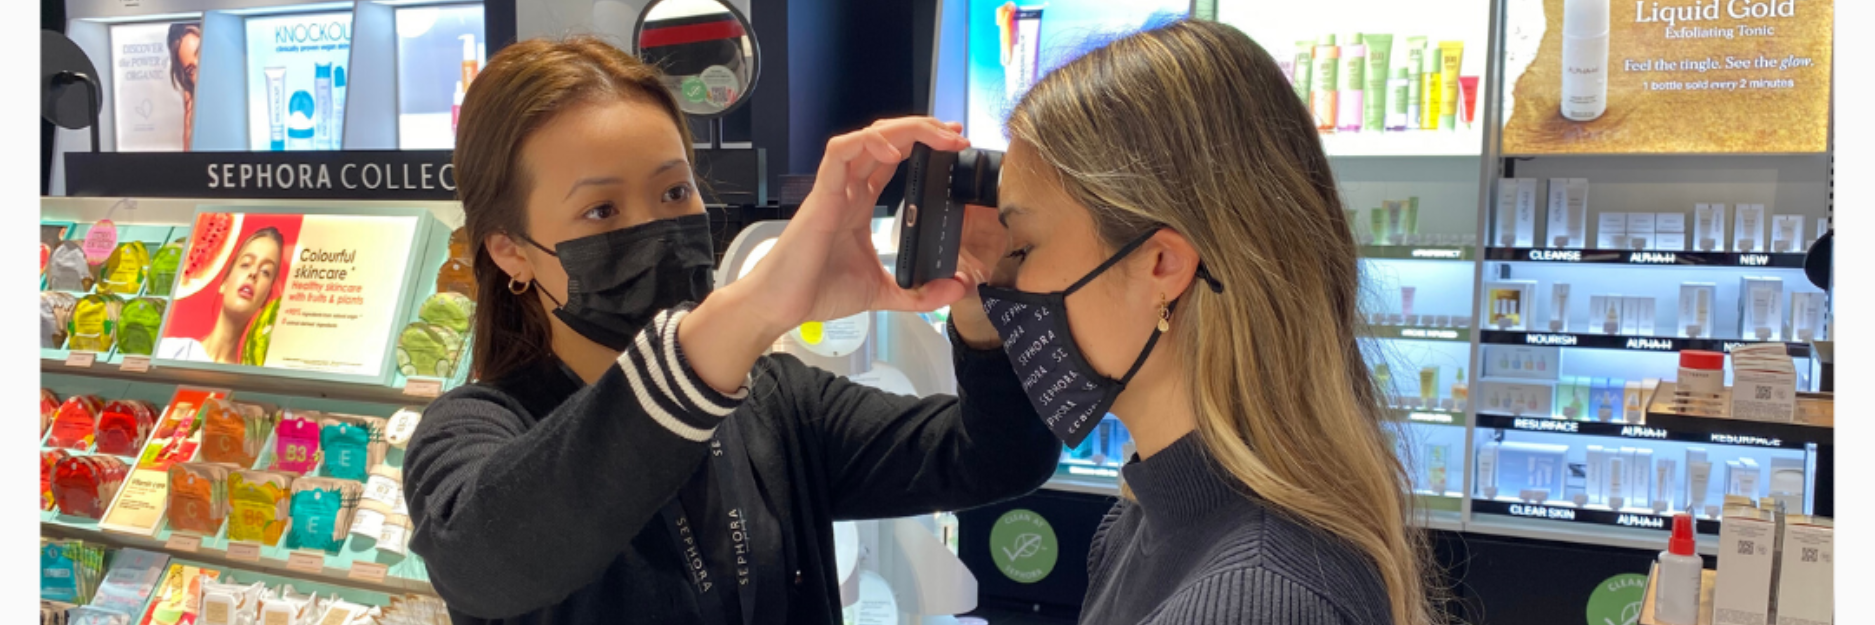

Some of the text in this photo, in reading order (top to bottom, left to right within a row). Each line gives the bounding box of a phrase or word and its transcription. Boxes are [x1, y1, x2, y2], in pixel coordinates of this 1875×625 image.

[1635, 0, 1795, 26] Liquid Gold
[1665, 24, 1775, 39] Exfoliating Tonic
[123, 42, 164, 54] DISCOVER
[118, 57, 131, 67] the
[132, 56, 161, 67] POWER
[1624, 54, 1814, 72] Feel the tingle. See the glow.
[126, 70, 164, 81] ORGANIC
[1643, 78, 1795, 92] 1 bottle sold every 2 minutes
[207, 163, 456, 191] SEPHORA COLLEC
[299, 248, 357, 264] Colourful
[1529, 250, 1581, 262] CLEANSE
[1739, 253, 1770, 266] NEW
[294, 264, 348, 281] skincare
[291, 280, 363, 293] Healthy skincare
[288, 292, 364, 306] with fruits & plants
[1526, 333, 1577, 346] NOURISH
[1018, 329, 1056, 367] SEPHORA
[1039, 370, 1079, 407] SEPHORA
[1514, 418, 1579, 433] RESURFACE
[219, 436, 231, 451] C
[285, 444, 307, 463] B3
[338, 450, 351, 467] E
[186, 501, 198, 518] C
[1509, 504, 1576, 520] CLEAR SKIN
[306, 516, 321, 534] E
[1004, 513, 1031, 525] CLEAN
[676, 516, 713, 593] SEPHORA
[727, 508, 749, 586] SEPHORA
[1004, 564, 1043, 580] SEPHORA
[1607, 578, 1645, 593] CLEAN
